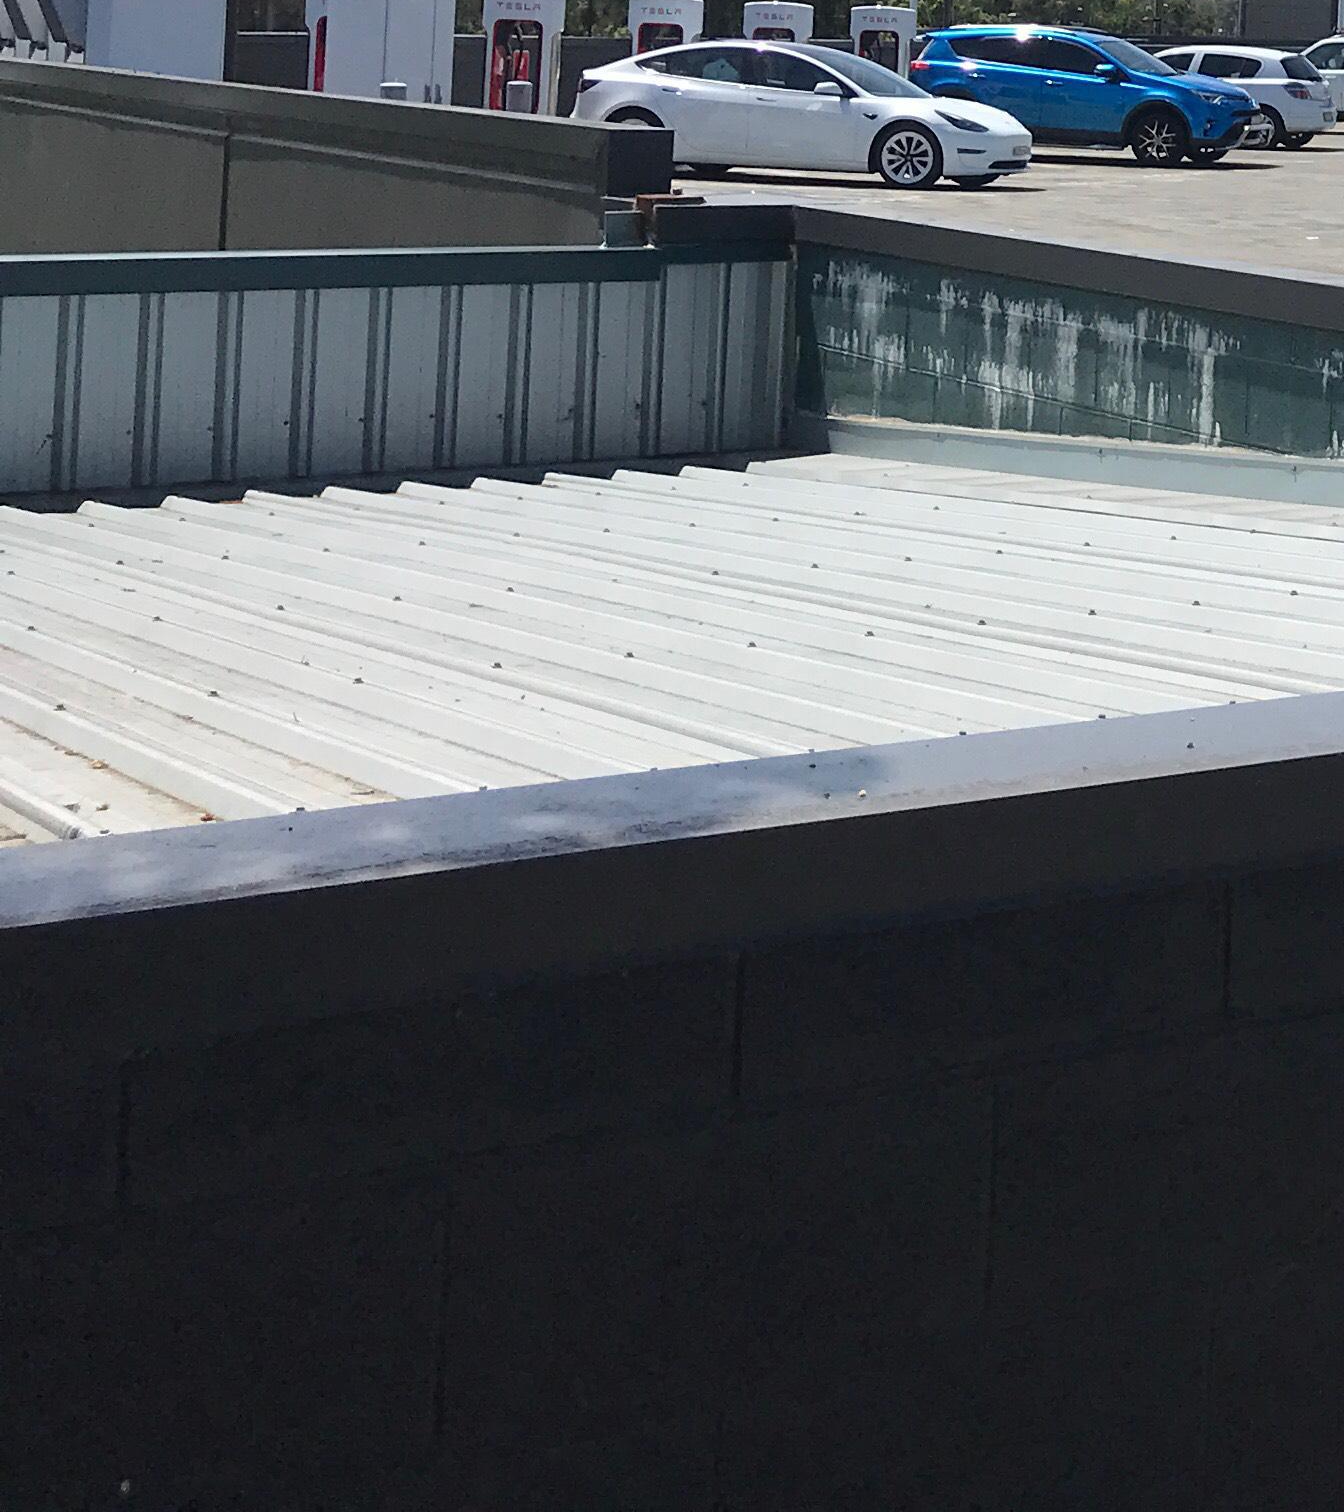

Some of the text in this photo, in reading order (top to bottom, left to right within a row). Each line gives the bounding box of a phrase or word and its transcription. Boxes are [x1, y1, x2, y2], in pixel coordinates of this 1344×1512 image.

[496, 1, 541, 11] TESLA
[641, 7, 682, 16] TESLA
[755, 12, 794, 21] TESLA
[862, 15, 898, 24] TESLA
